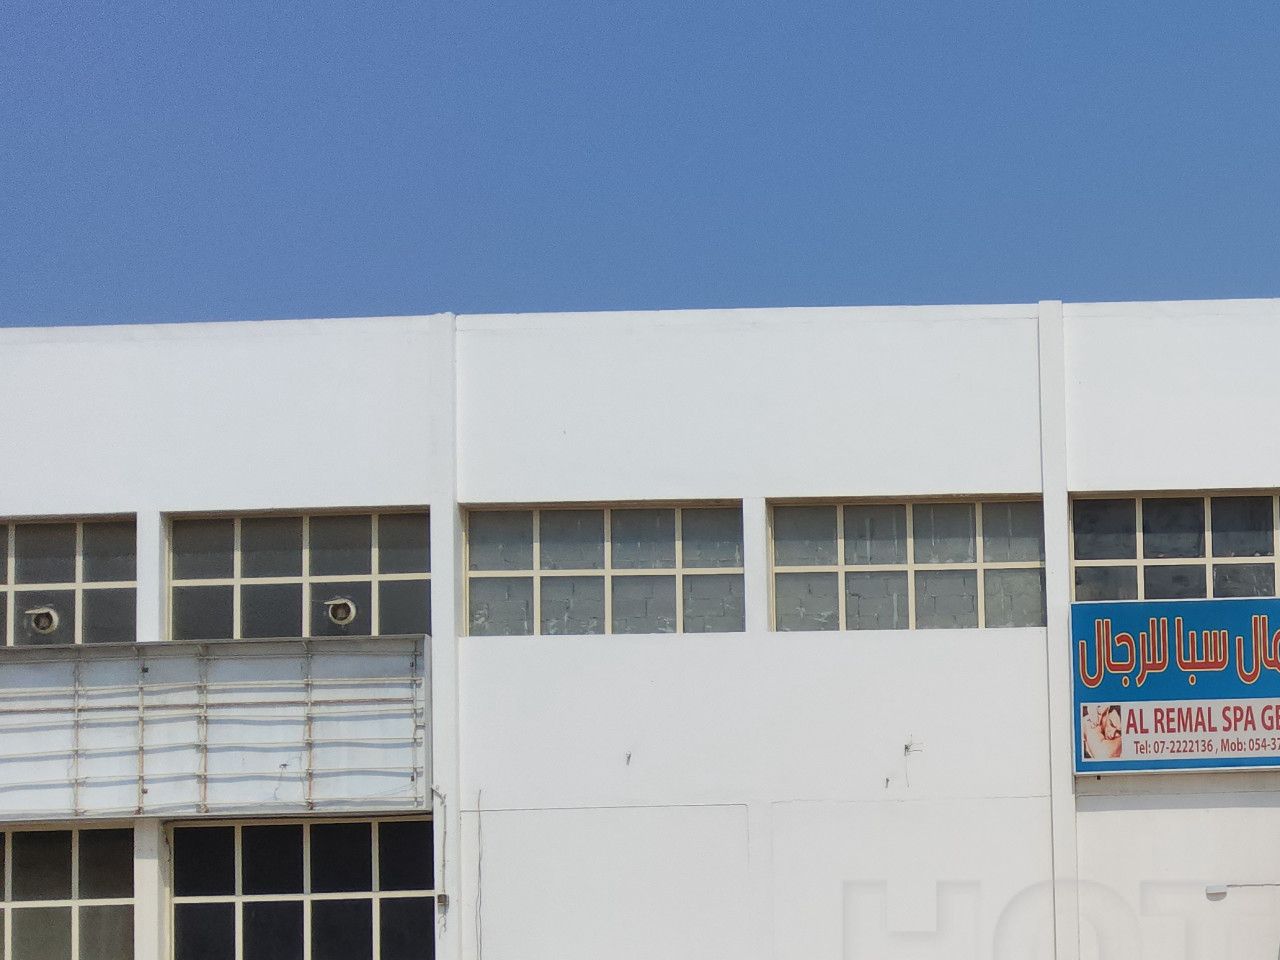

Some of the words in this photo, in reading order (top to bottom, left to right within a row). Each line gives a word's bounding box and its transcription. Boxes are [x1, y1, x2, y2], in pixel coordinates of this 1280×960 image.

[1078, 617, 1169, 689] للرجال
[1175, 616, 1229, 686] سبا
[1126, 709, 1149, 734] AL
[1154, 707, 1218, 733] REMAL
[1222, 705, 1257, 732] SPA
[1134, 740, 1151, 755] Tel:
[1153, 739, 1213, 754] 07-2222136
[1220, 738, 1246, 752] Mob:
